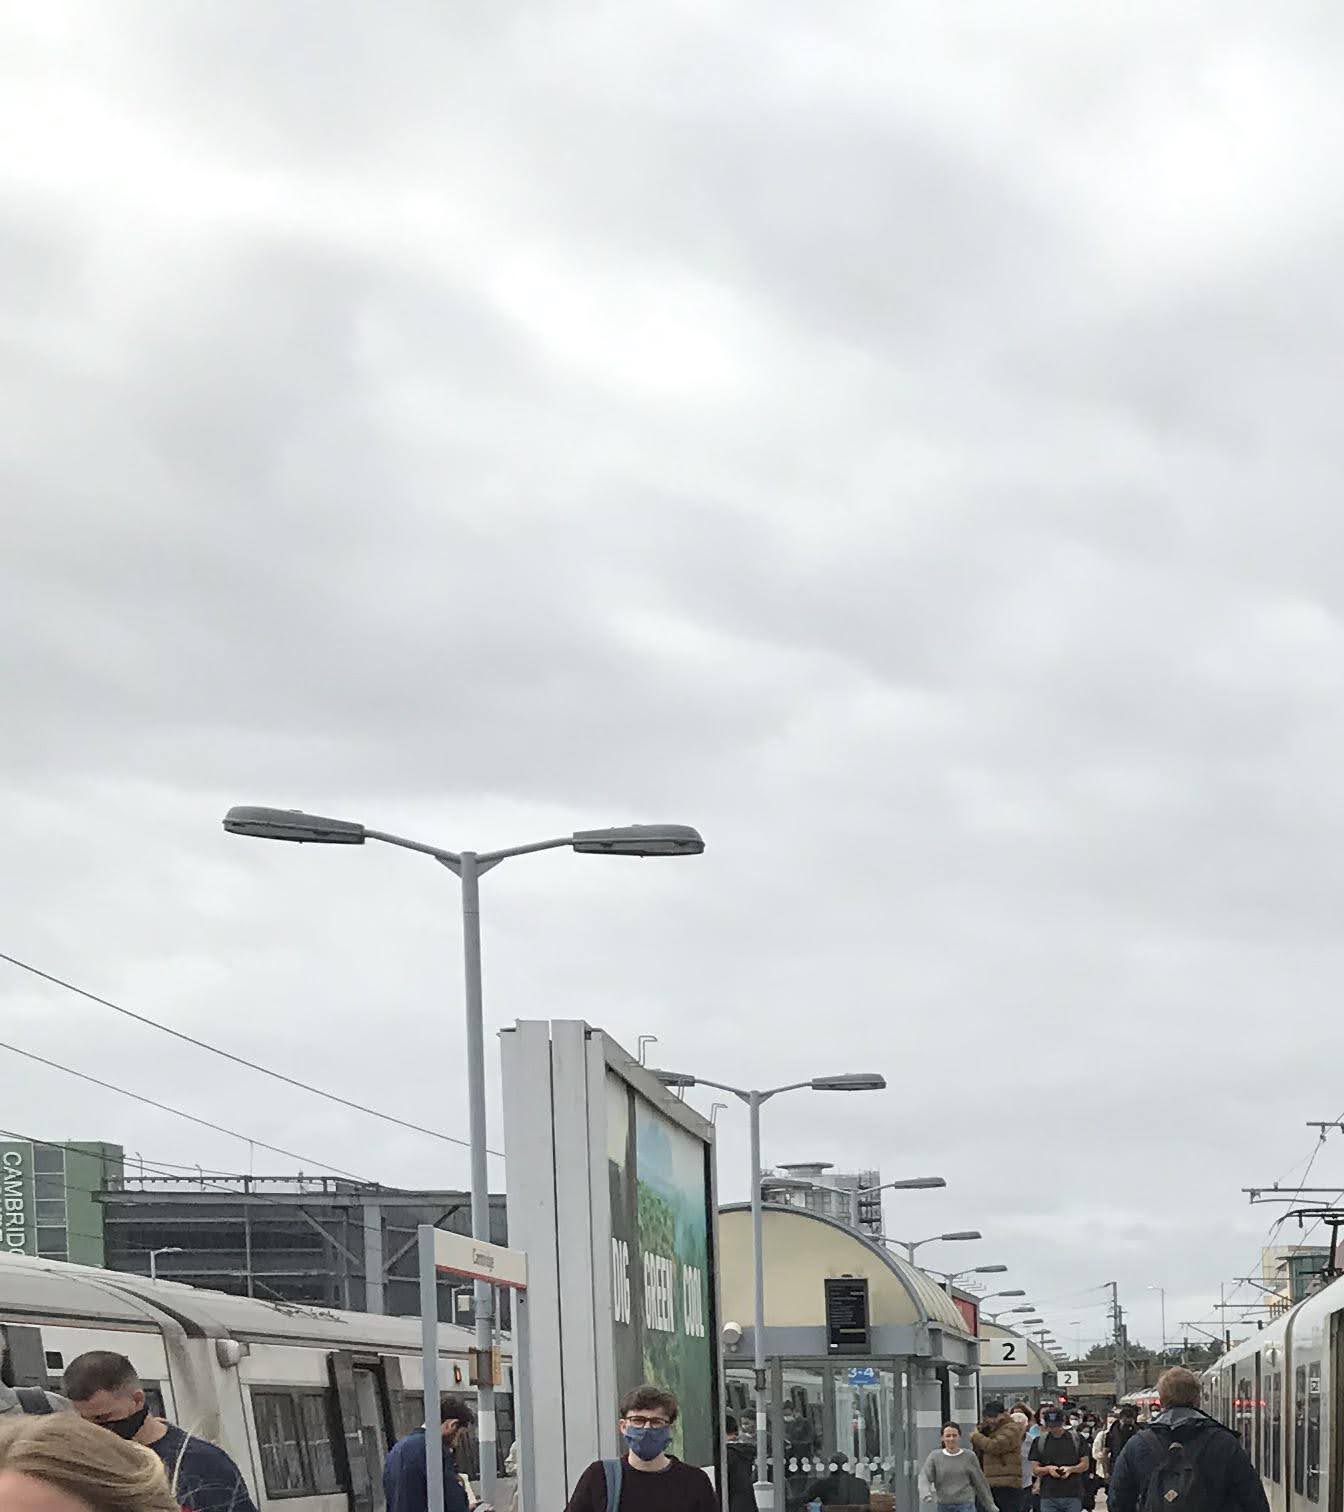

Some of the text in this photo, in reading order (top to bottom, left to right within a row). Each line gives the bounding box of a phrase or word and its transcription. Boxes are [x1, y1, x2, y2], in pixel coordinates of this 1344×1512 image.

[643, 1250, 675, 1333] GREEN
[1002, 1342, 1016, 1361] 2
[1064, 1373, 1073, 1385] 2
